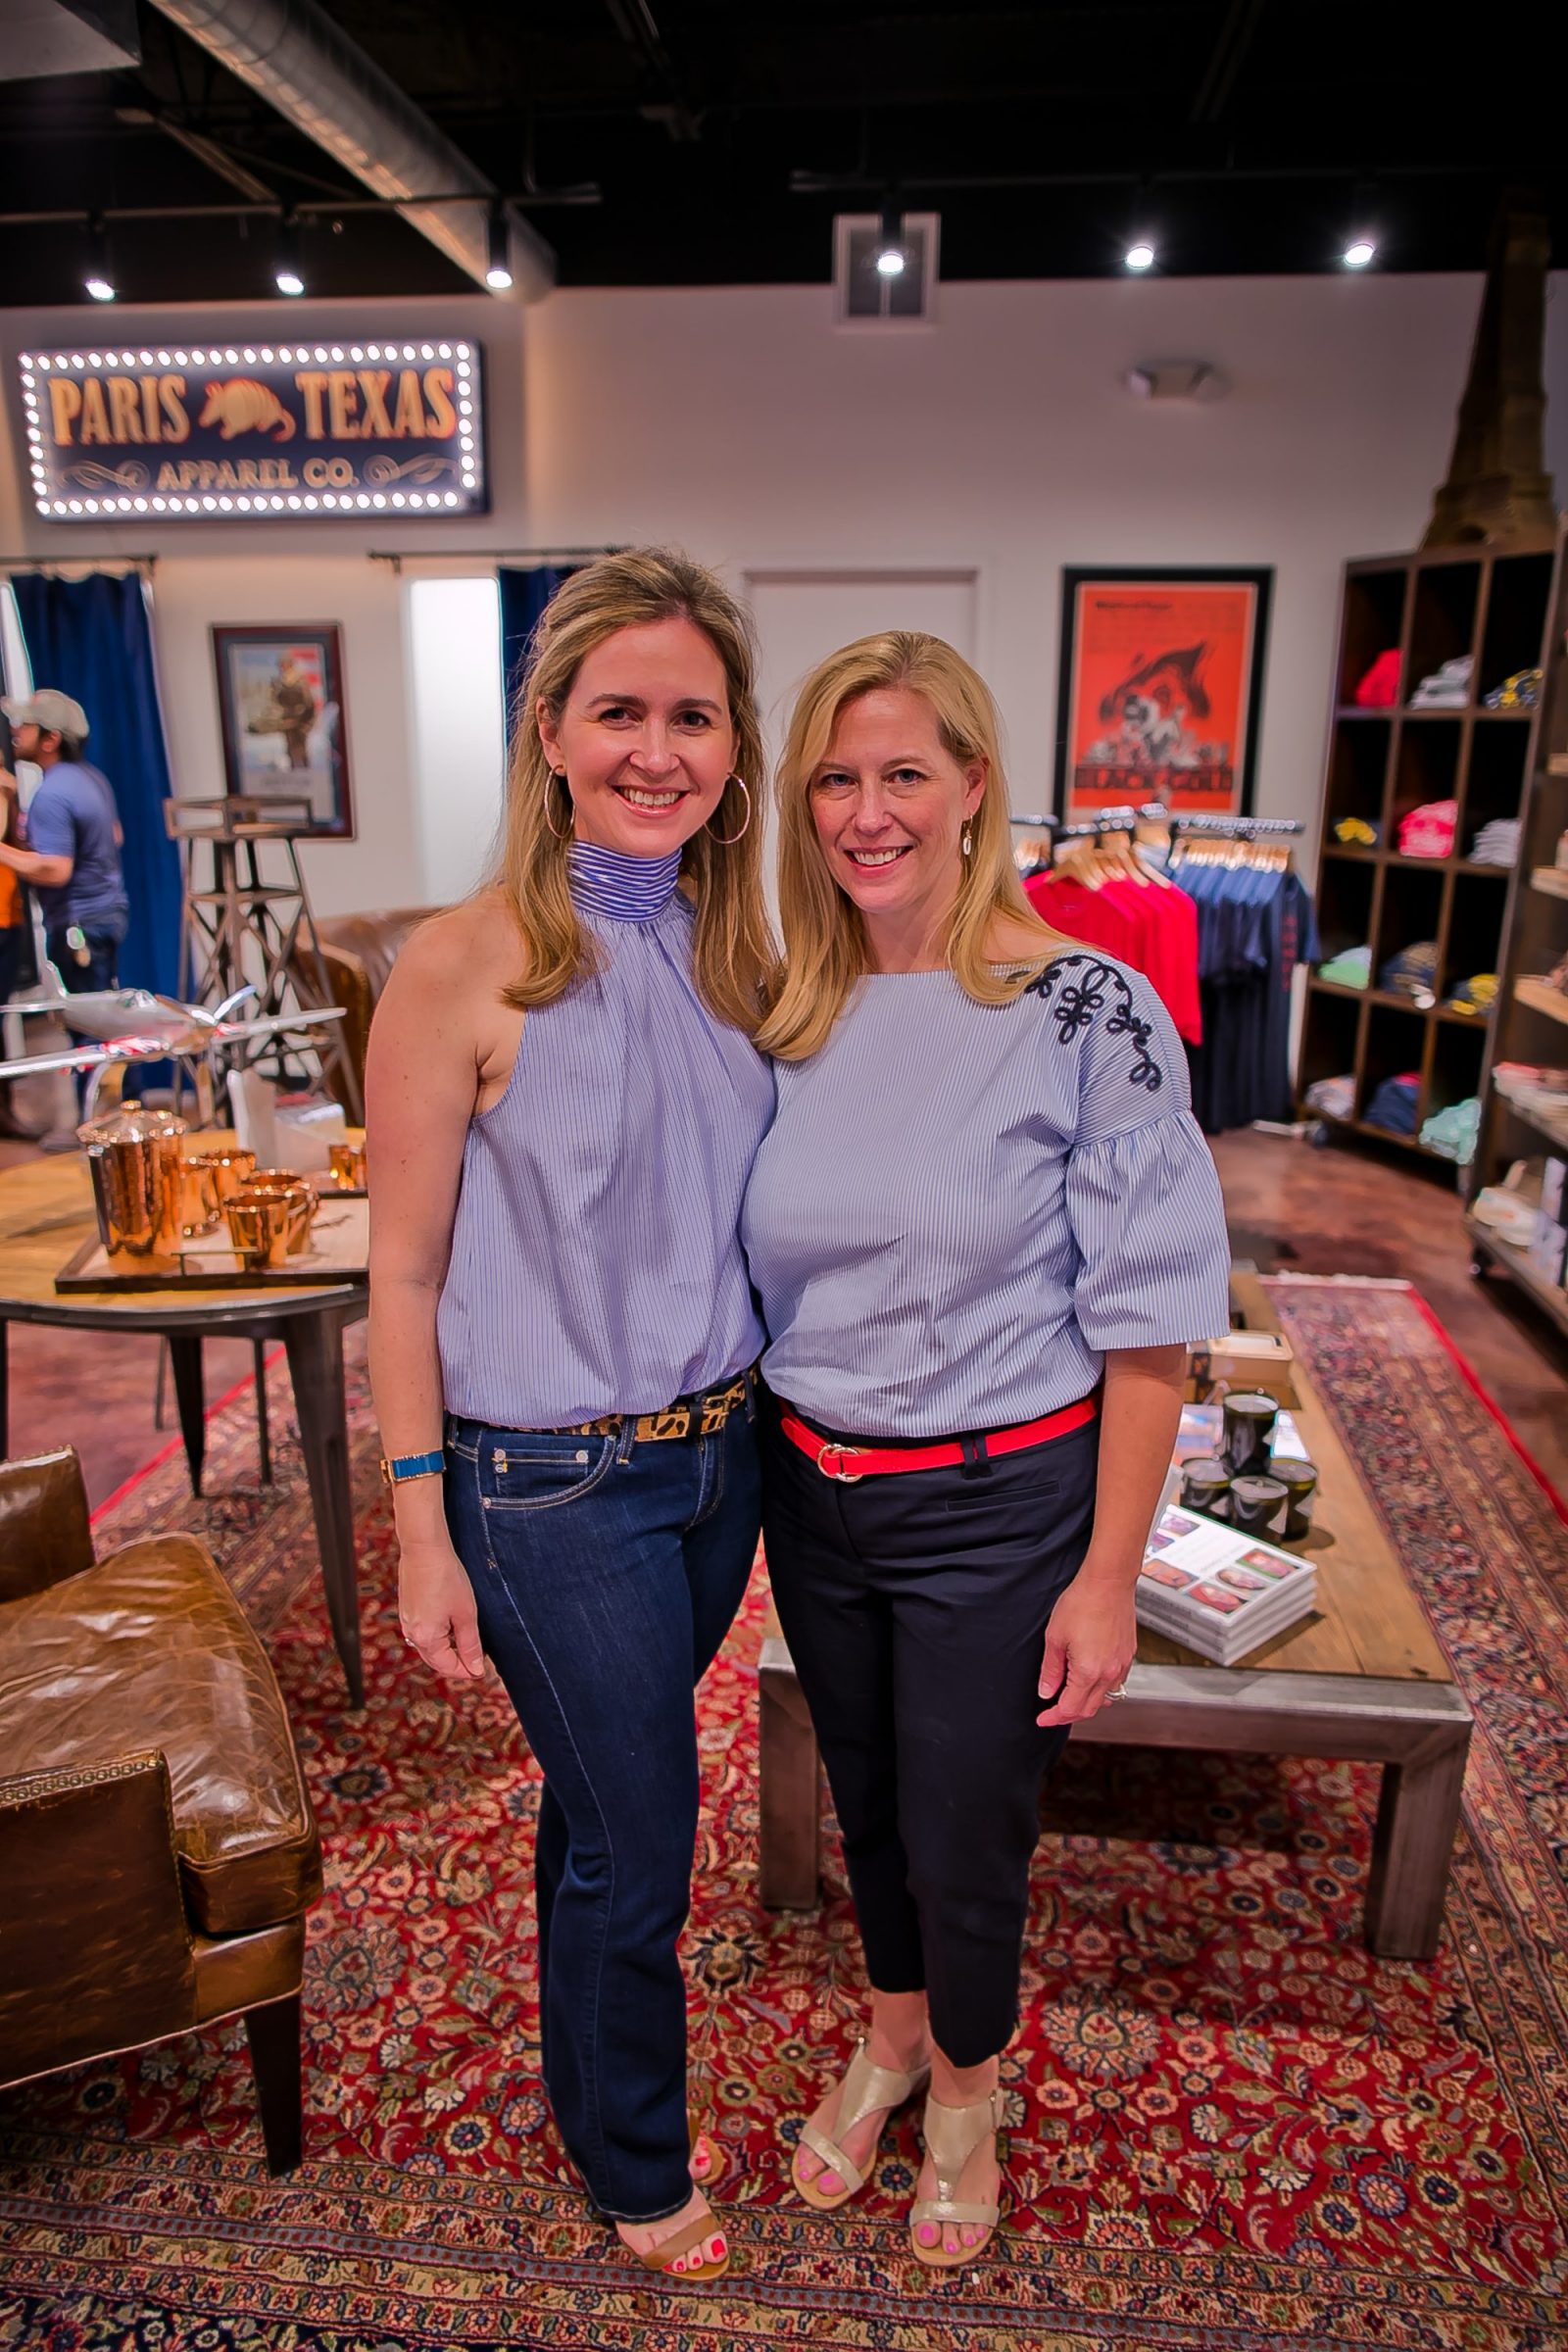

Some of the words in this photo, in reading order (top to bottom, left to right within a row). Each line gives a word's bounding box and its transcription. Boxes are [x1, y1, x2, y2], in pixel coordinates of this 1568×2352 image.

[47, 373, 190, 446] PARIS
[295, 368, 457, 440] TEXAS
[157, 459, 299, 490] APPAREL
[303, 457, 361, 488] CO.
